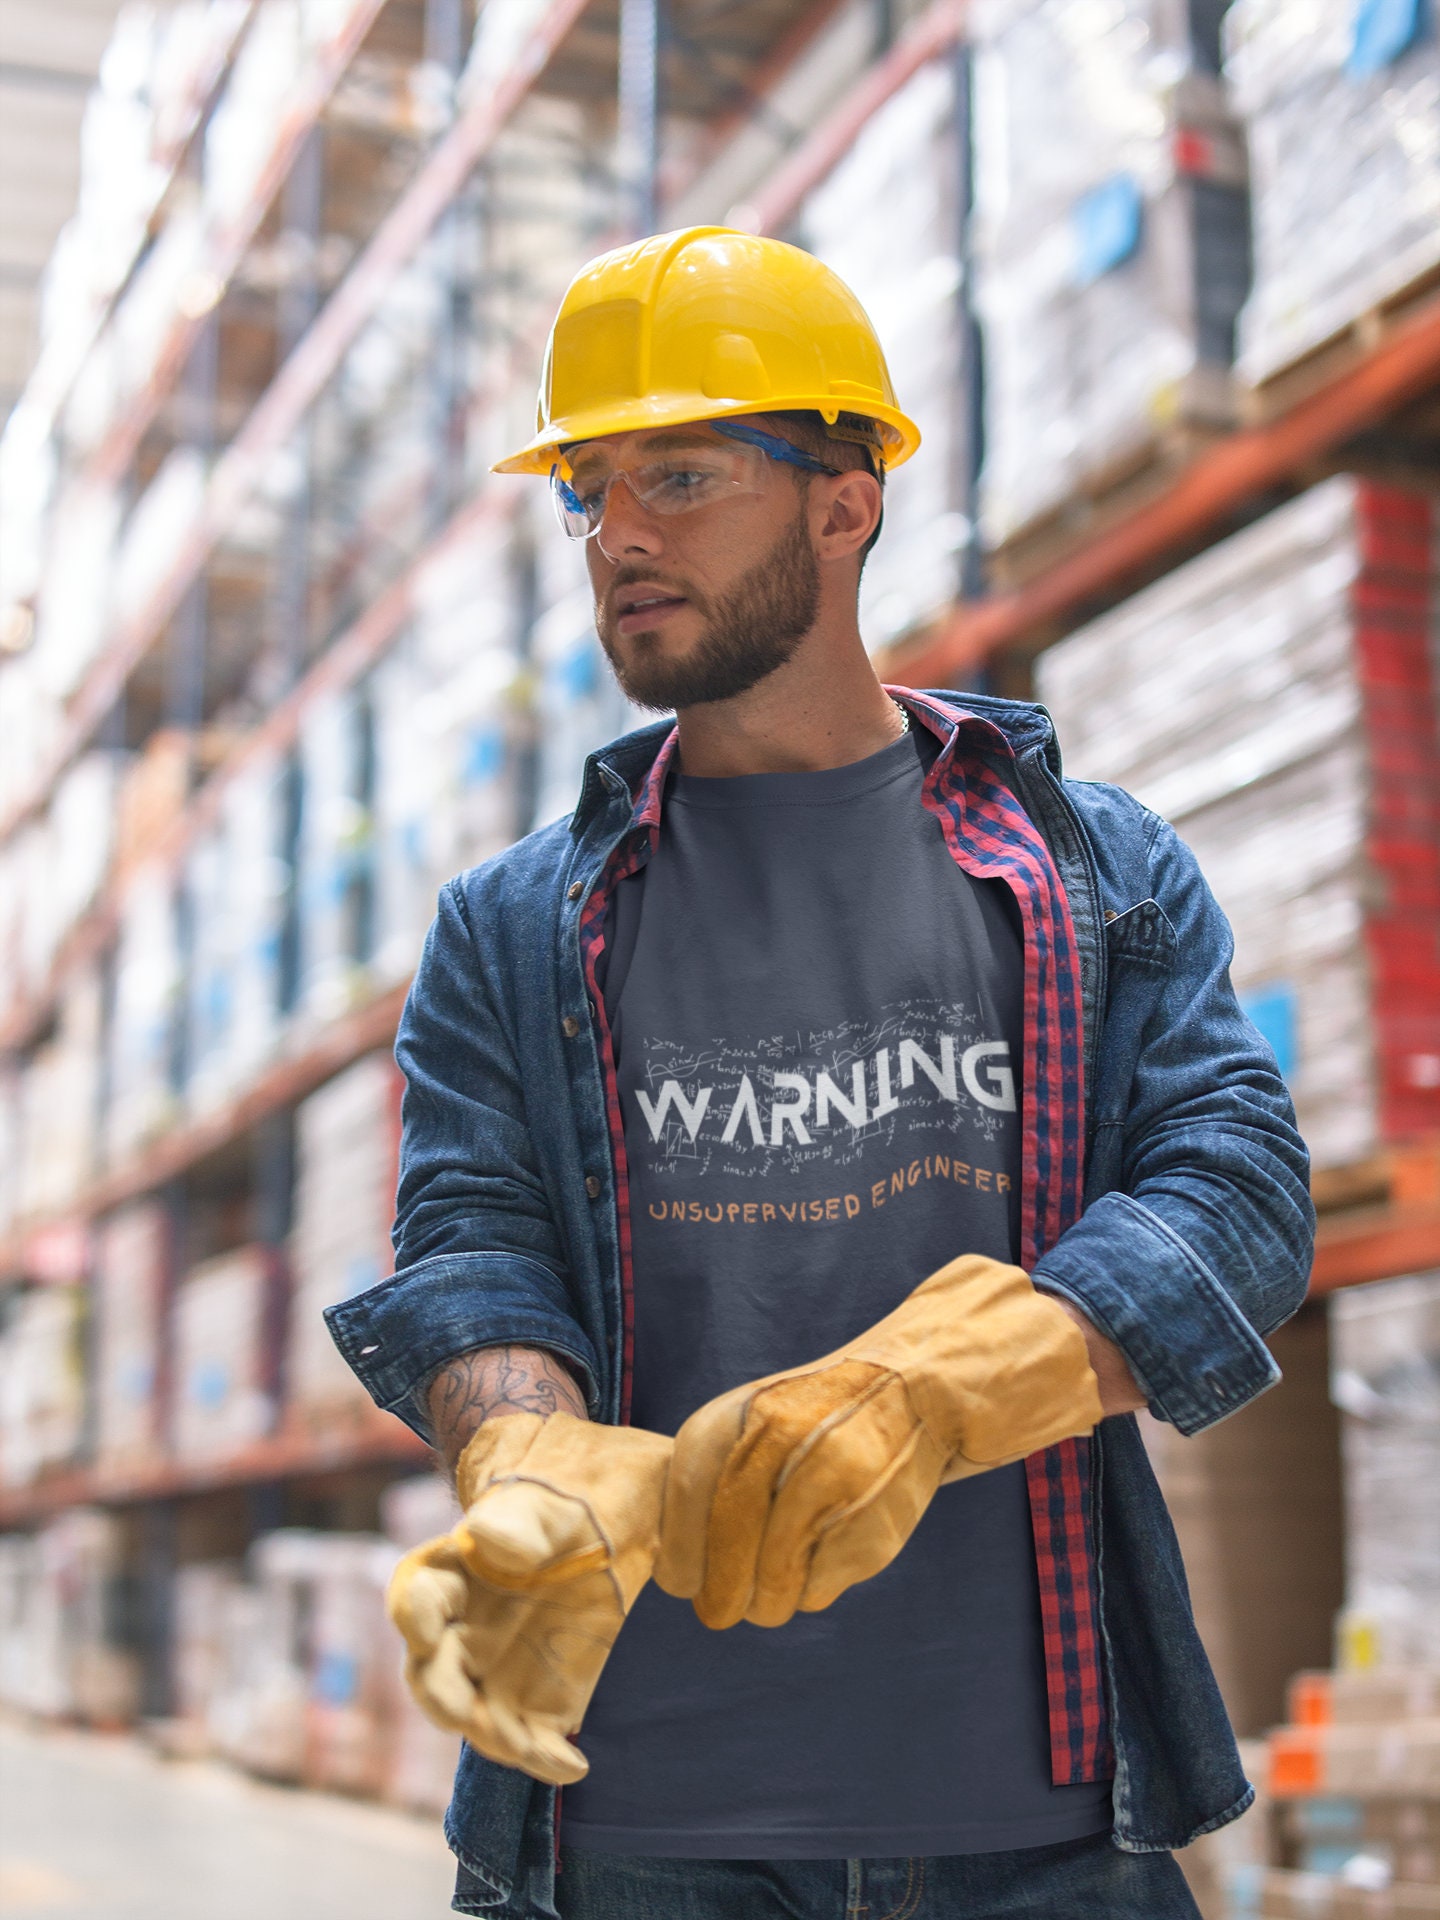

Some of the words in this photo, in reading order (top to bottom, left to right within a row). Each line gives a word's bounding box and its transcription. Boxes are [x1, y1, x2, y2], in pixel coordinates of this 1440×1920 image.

[634, 1035, 1017, 1146] WARNING
[649, 1194, 860, 1223] UNSUPERVISED
[871, 1154, 1012, 1208] ENGINEER
